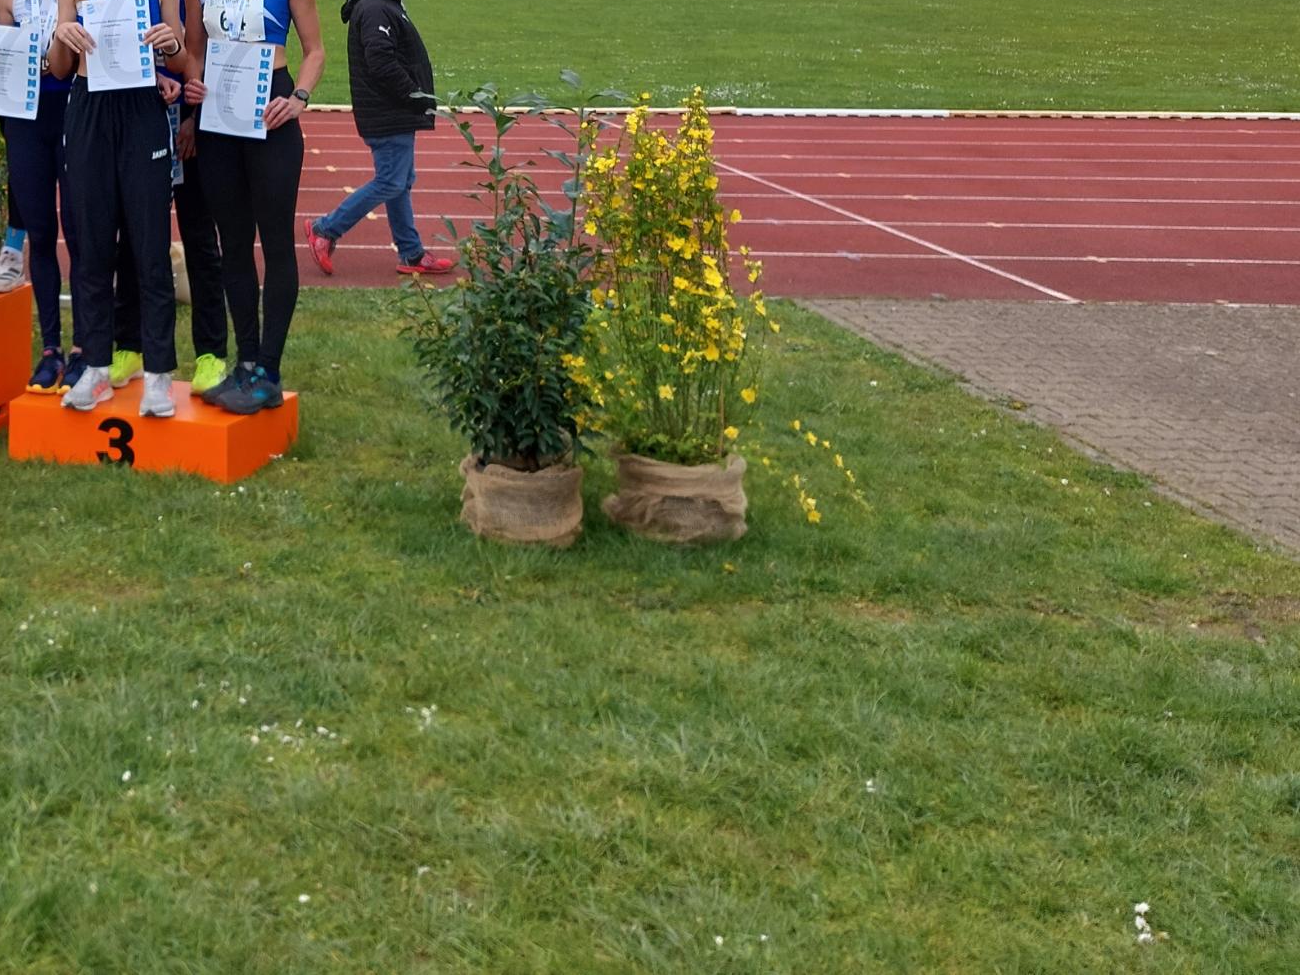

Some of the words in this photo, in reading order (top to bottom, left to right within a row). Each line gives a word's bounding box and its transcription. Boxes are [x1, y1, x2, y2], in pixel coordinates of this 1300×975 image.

[26, 33, 38, 111] URKUNDE
[254, 48, 271, 129] URKUNDE
[96, 416, 135, 467] 3
